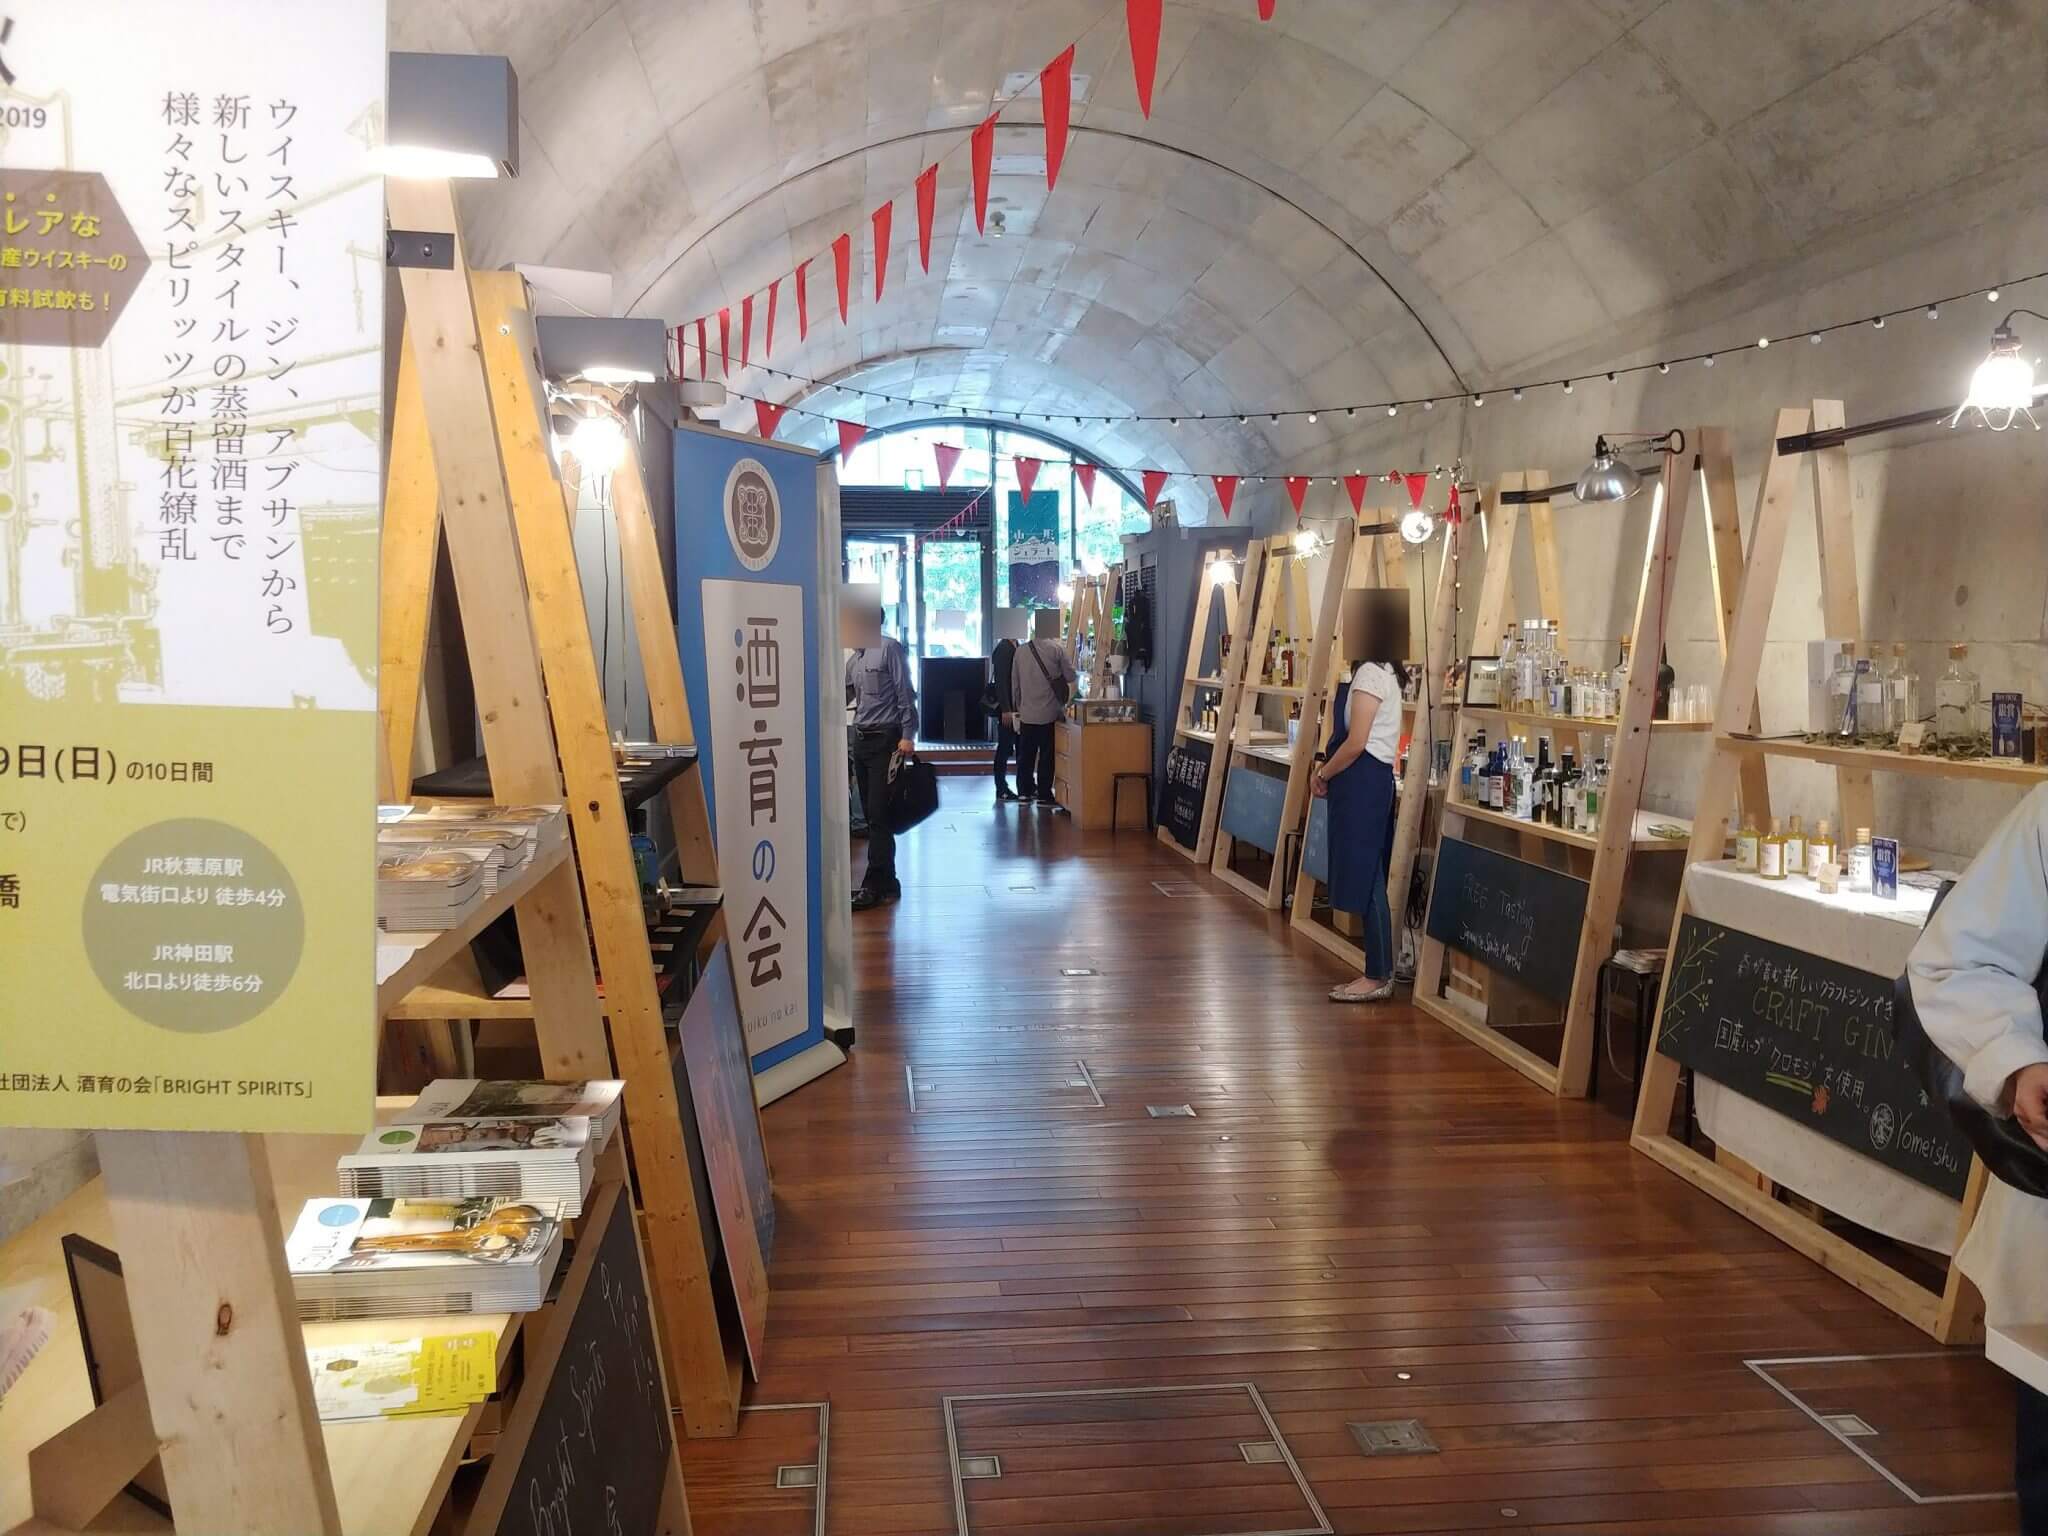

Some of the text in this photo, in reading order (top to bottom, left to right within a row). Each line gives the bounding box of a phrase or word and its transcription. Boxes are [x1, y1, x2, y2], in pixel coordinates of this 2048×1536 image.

[5, 208, 101, 238] レアな
[159, 91, 201, 561] 様々なスピリッツが百花繚乱
[210, 93, 252, 560] 新しいスタイルの蒸留酒まで
[261, 98, 299, 634] ウイスキー、ジン、アブサンから
[126, 761, 214, 783] の10日間
[734, 617, 786, 988] 酒育の会
[143, 856, 244, 877] JR秋葉原駅
[100, 883, 287, 907] 電気街口より 徒歩4分
[152, 944, 234, 963] JR神田駅
[123, 971, 264, 993] 北口より徒歩6分
[1752, 986, 1895, 1060] CRAFT GIN
